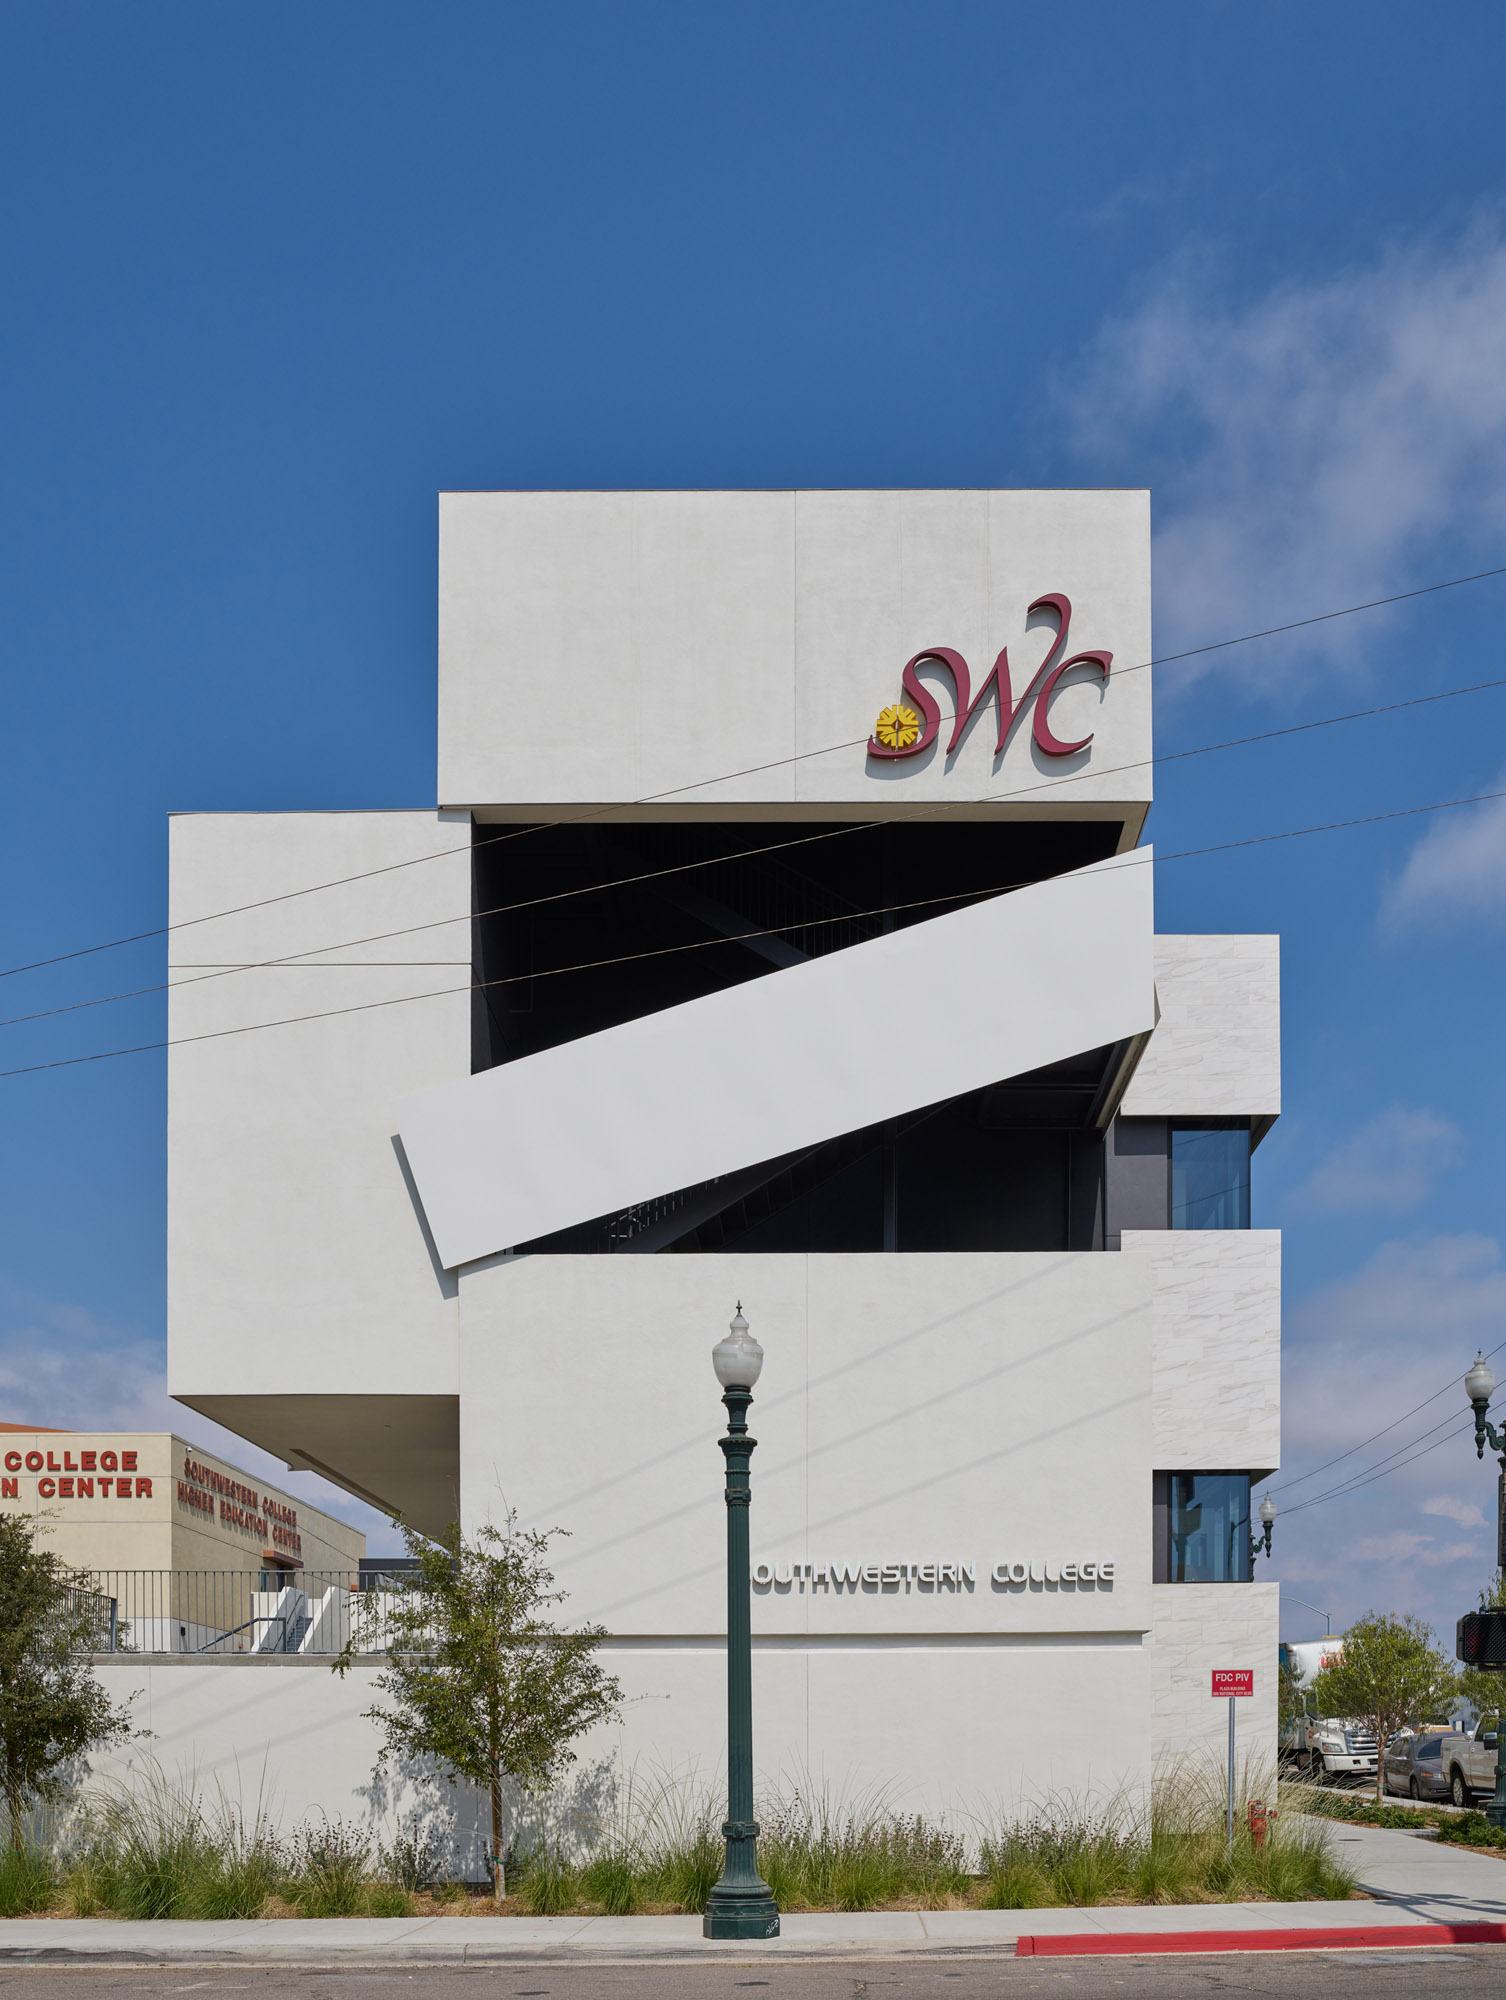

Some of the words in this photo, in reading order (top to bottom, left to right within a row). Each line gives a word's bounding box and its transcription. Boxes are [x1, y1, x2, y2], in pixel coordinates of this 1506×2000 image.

[867, 592, 1114, 760] SWC
[4, 1450, 138, 1472] COLLEGE
[38, 1477, 153, 1498] CENTER
[184, 1457, 258, 1510] SOUTHWESTERN
[262, 1496, 297, 1528] COLLEGE
[177, 1480, 214, 1515] HIGHER
[219, 1499, 268, 1538] EDUCATION
[272, 1524, 301, 1551] CENTER
[751, 1559, 977, 1585] OUTHWESTERN
[991, 1559, 1117, 1584] COLLEGE
[1215, 1673, 1233, 1682] FDC
[1235, 1673, 1250, 1682] PIV
